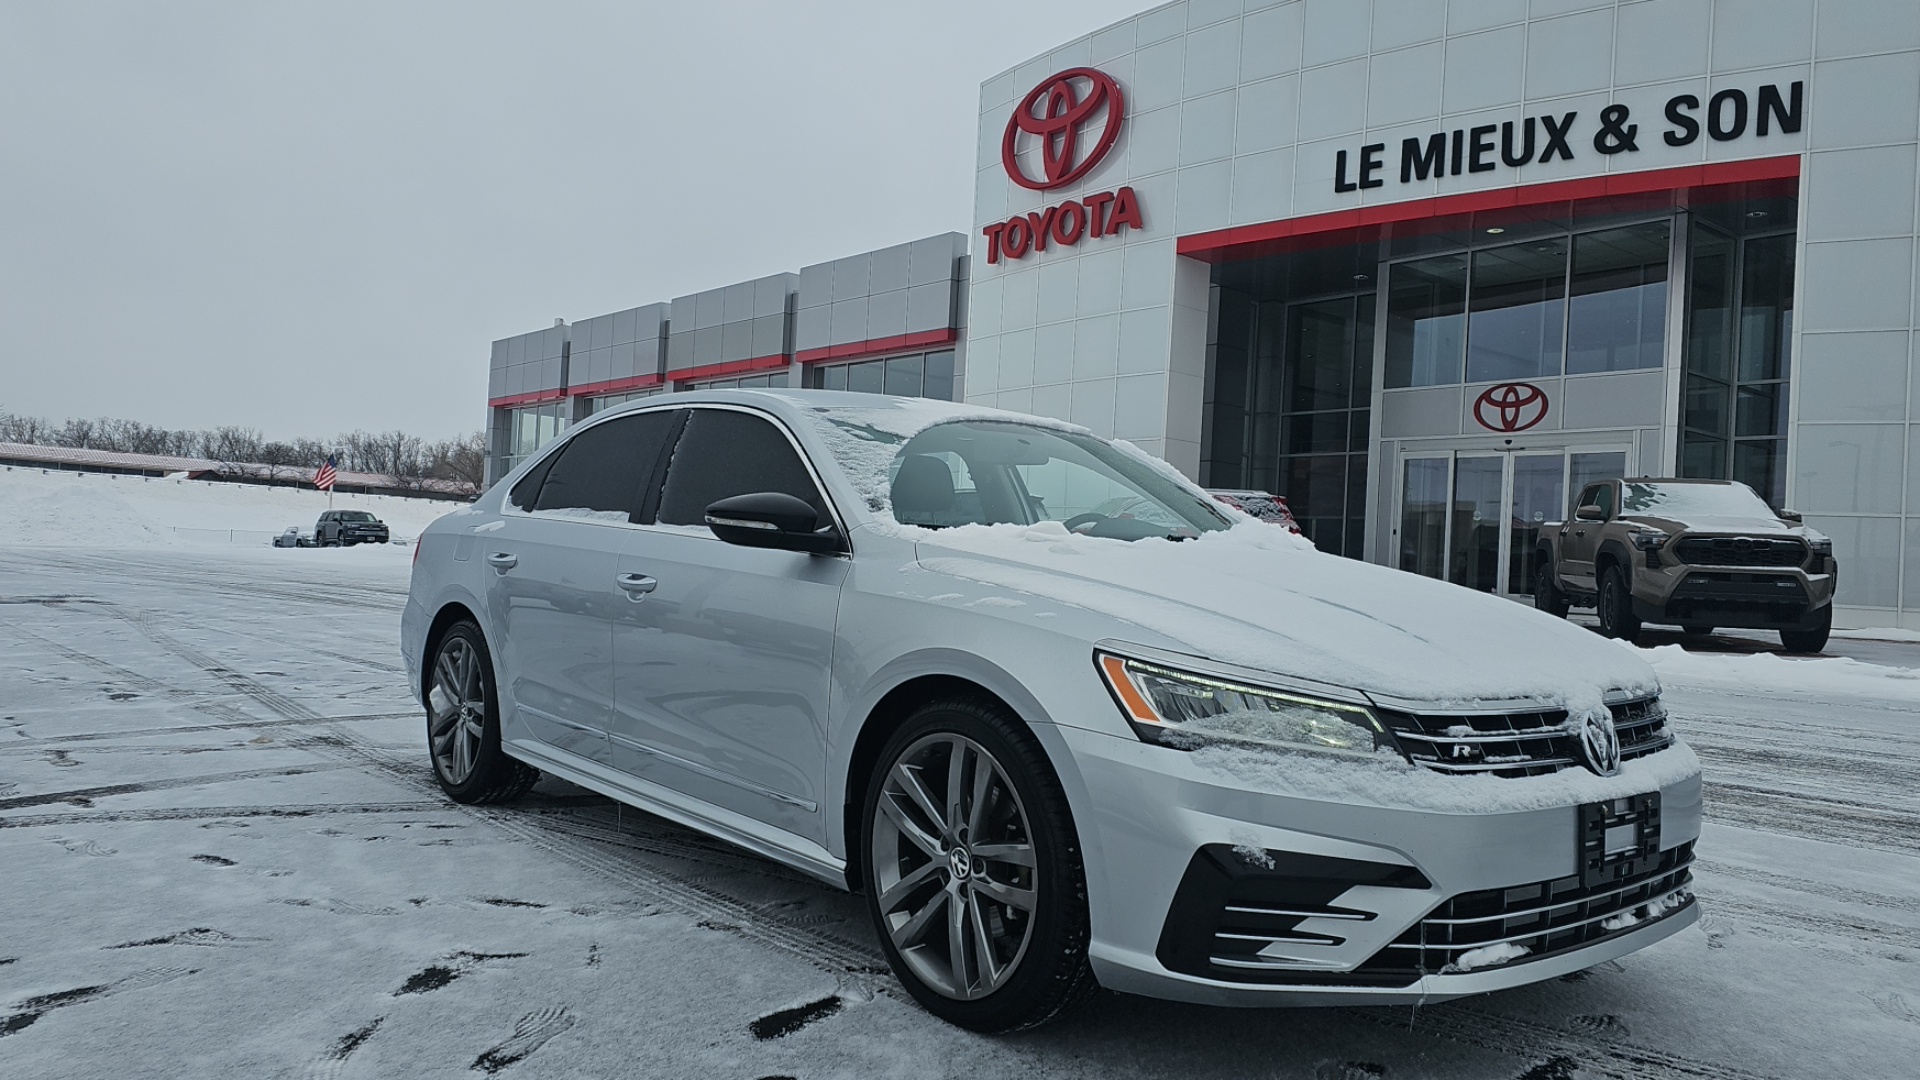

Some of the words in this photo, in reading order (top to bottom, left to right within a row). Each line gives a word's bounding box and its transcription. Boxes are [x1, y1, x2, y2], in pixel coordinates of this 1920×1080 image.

[1334, 142, 1385, 193] LE
[1400, 111, 1578, 184] MIEUX
[1593, 103, 1640, 155] &
[1663, 80, 1804, 147] SON
[983, 186, 1144, 264] TOYOTA
